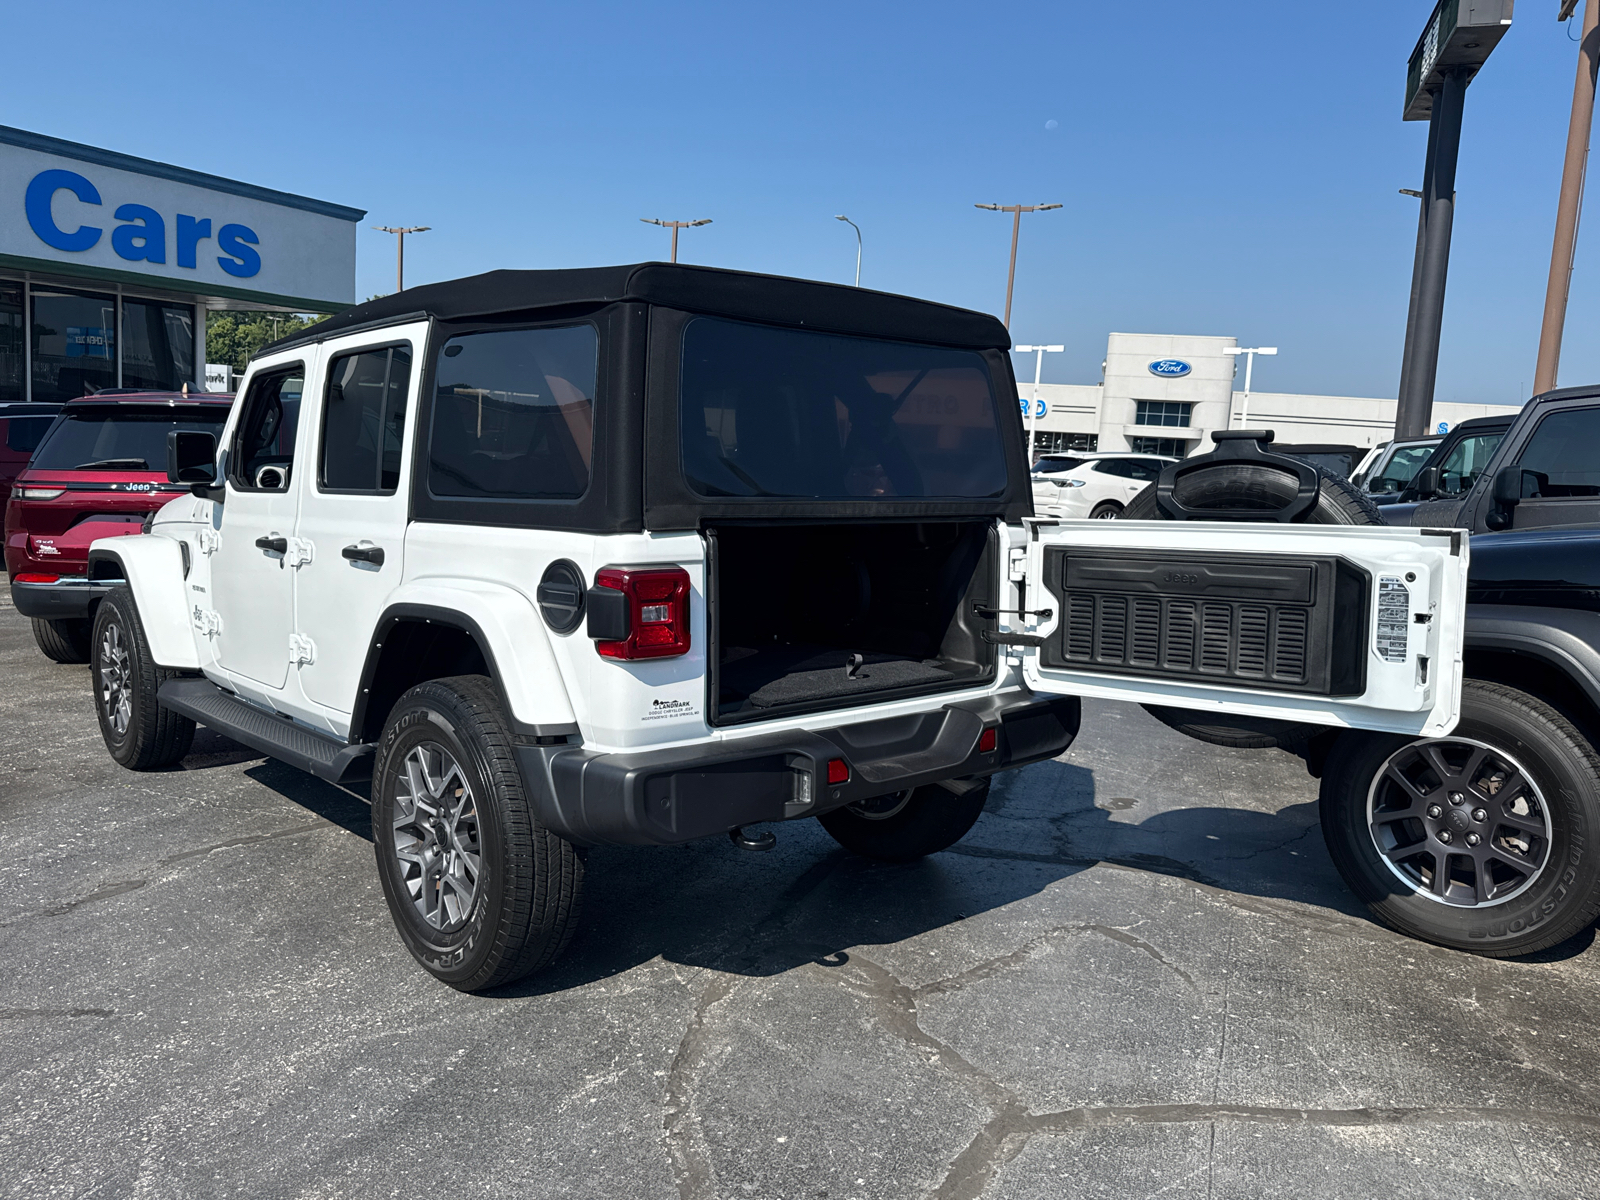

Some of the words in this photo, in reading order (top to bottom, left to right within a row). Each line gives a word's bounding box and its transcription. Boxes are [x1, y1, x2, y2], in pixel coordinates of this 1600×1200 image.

[25, 169, 261, 278] Cars
[1018, 398, 1047, 417] RD
[126, 482, 150, 491] Jeep
[1163, 570, 1198, 585] Jeep
[659, 701, 690, 709] LANDMARK
